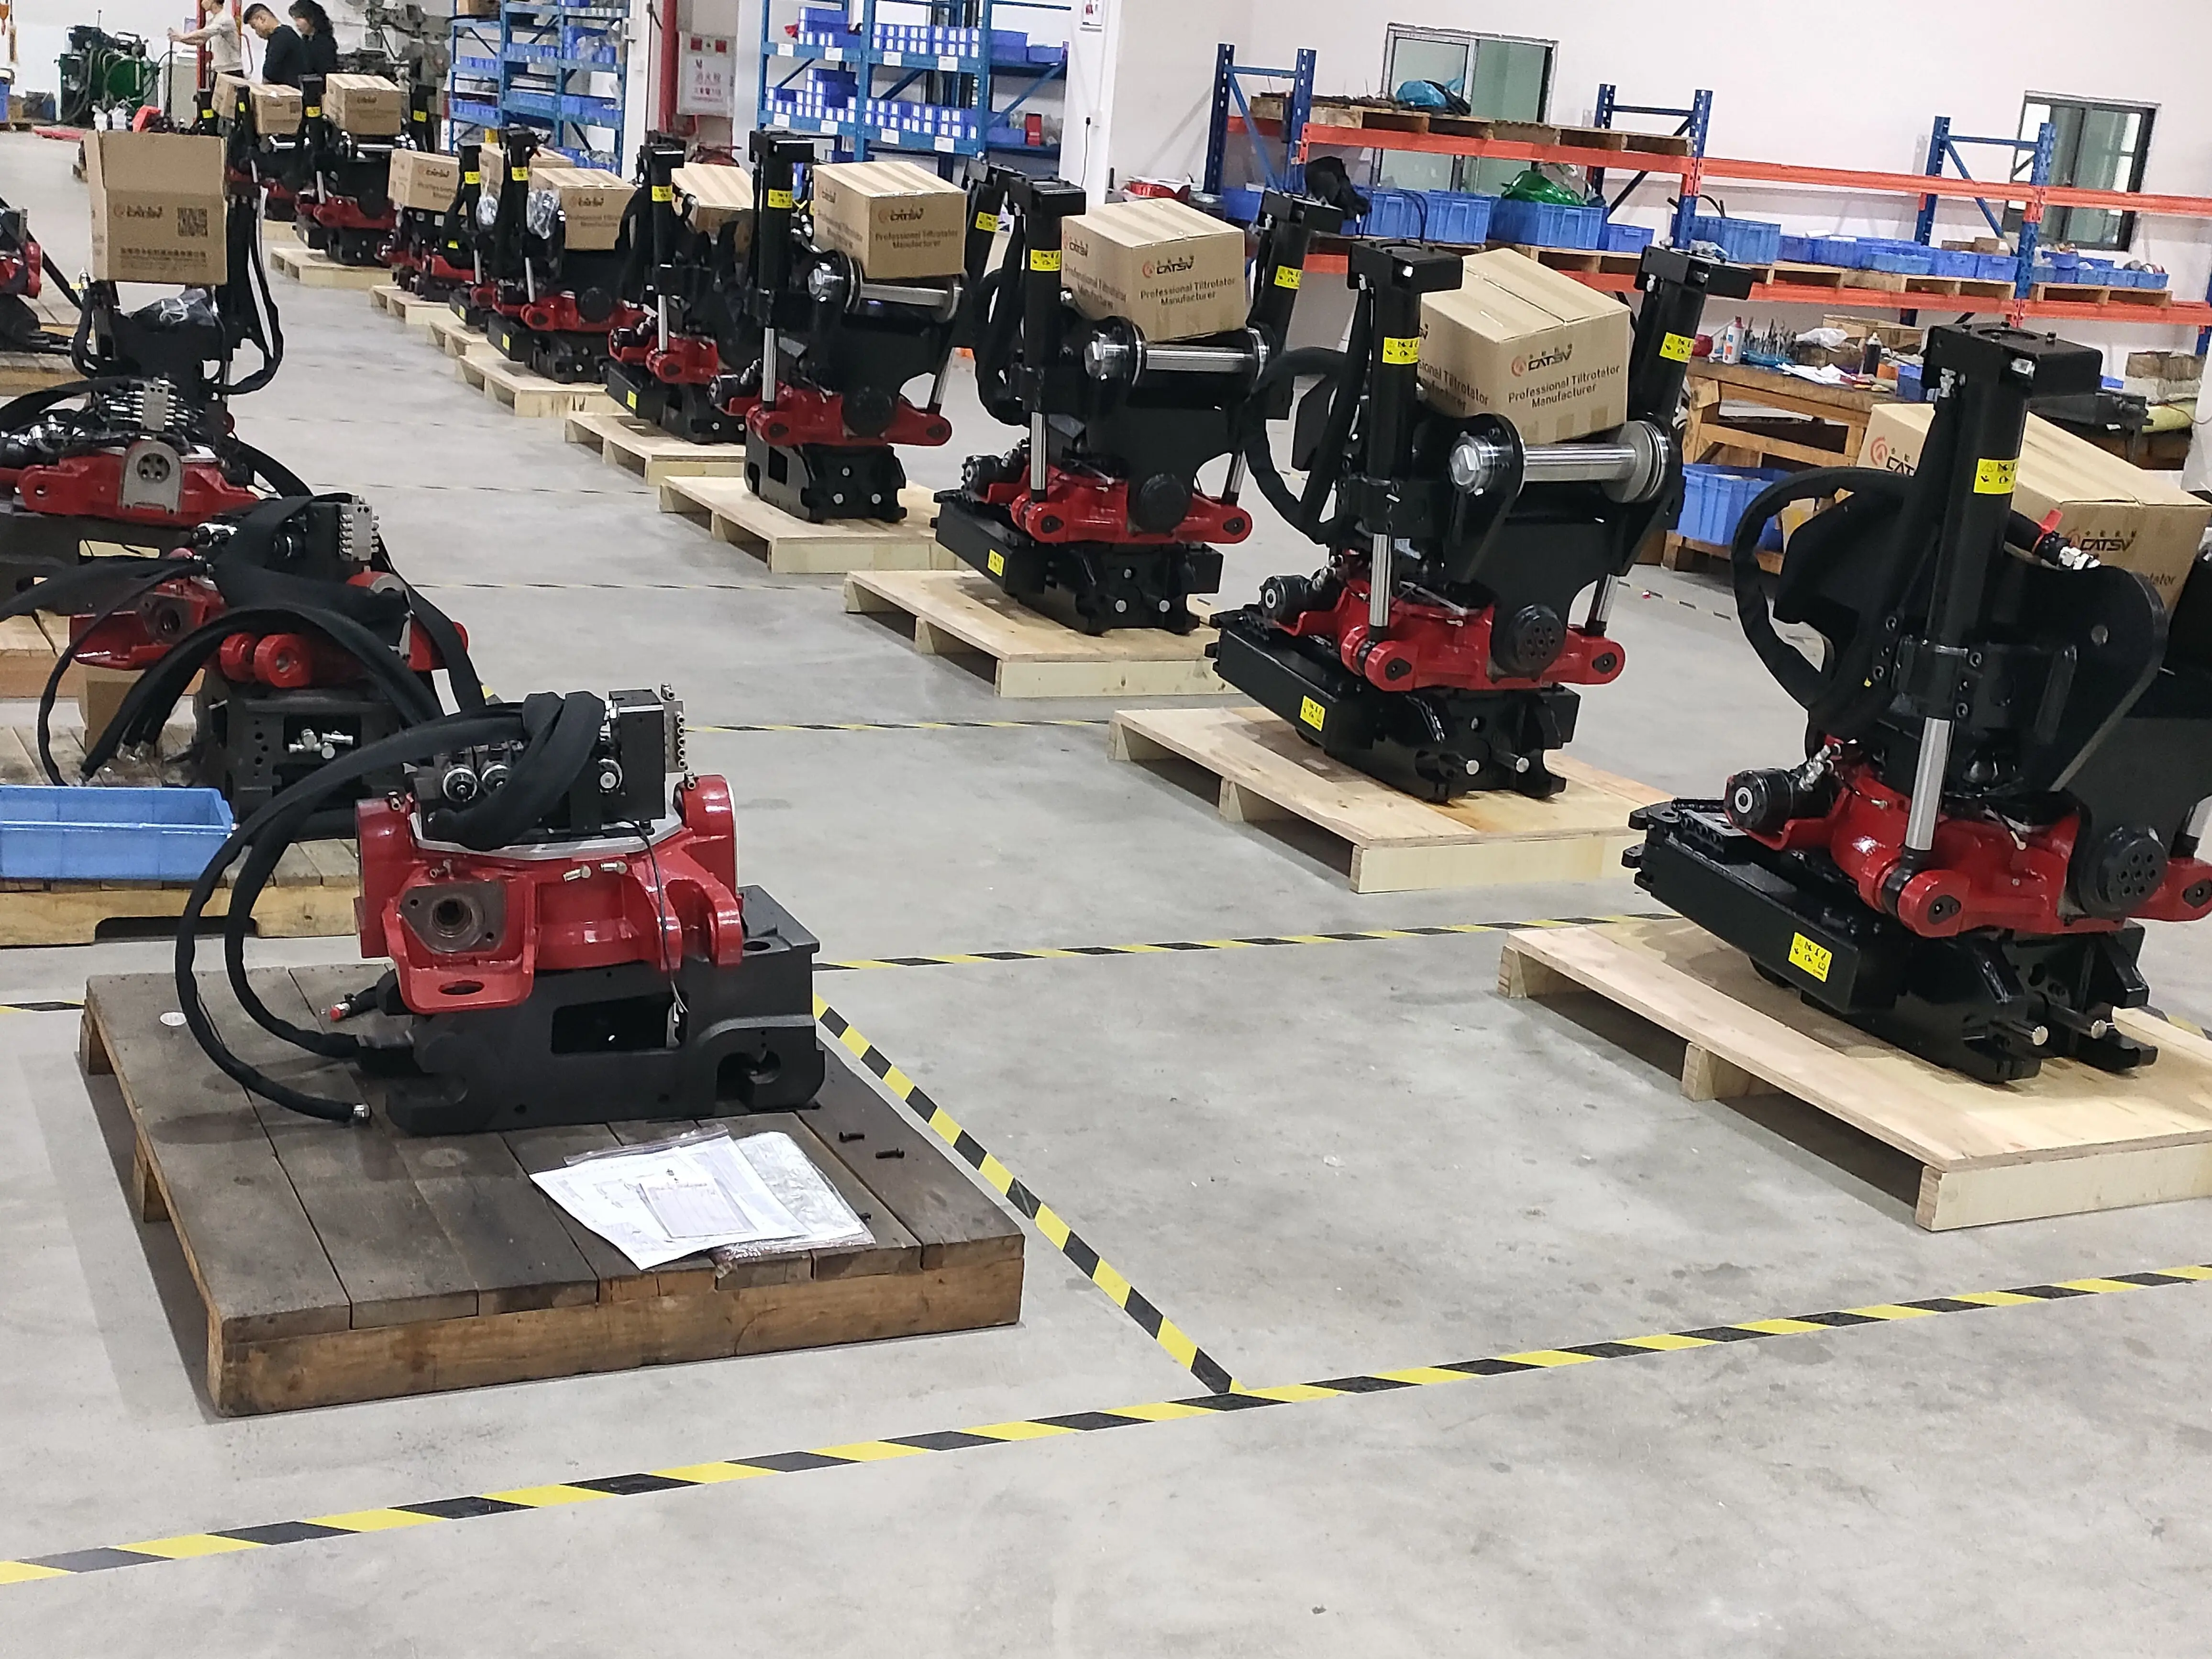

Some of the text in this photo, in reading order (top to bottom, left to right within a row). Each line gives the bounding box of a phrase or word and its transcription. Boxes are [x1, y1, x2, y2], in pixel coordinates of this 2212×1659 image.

[1157, 261, 1194, 275] CATSV
[1141, 277, 1235, 299] Professional Tiltrotator
[1161, 291, 1216, 306] Manufacturer
[1528, 350, 1572, 371] CATSV
[1444, 370, 1489, 406] Tiltrotator
[1509, 365, 1620, 403] Professional Tiltrotator
[1532, 384, 1597, 409] Manufacturer
[1886, 456, 1915, 476] CAT
[2081, 537, 2134, 552] CATSV
